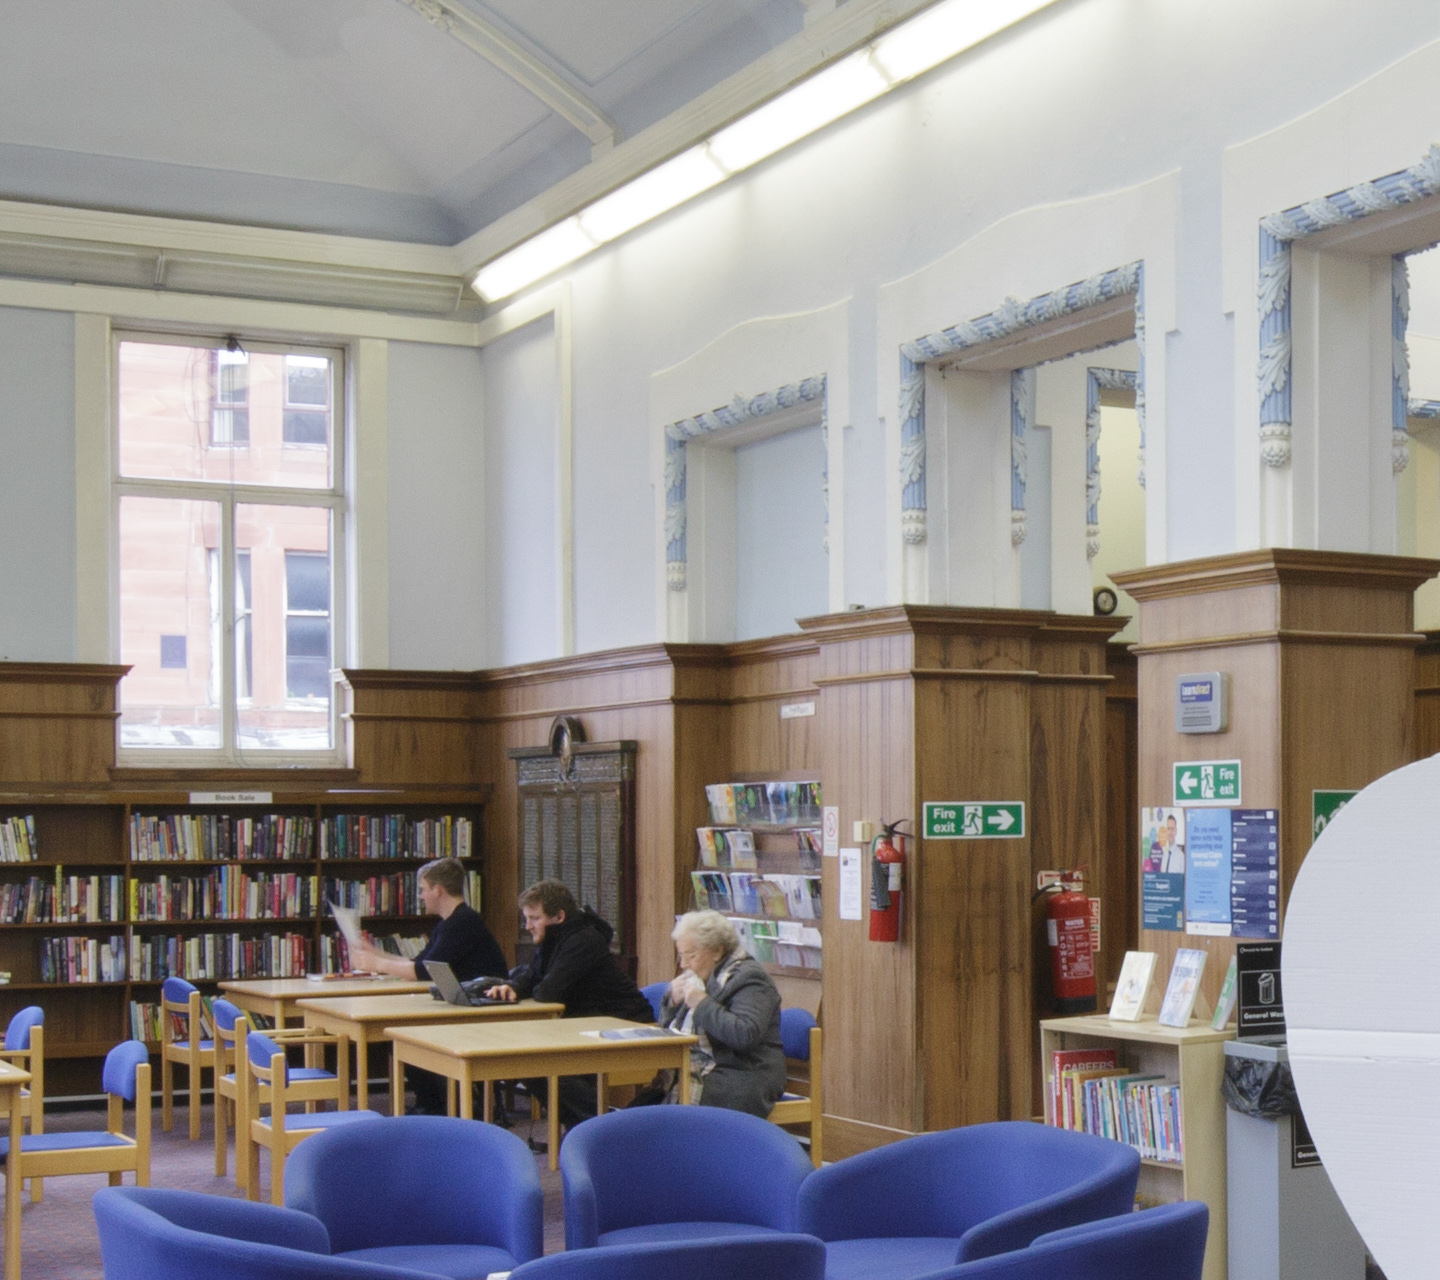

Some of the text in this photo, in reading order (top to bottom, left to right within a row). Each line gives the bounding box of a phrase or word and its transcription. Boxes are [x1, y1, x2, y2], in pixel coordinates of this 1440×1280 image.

[1220, 768, 1235, 780] Fire
[1220, 783, 1235, 795] exit
[933, 808, 955, 819] Fire
[933, 823, 955, 833] exit
[1244, 1011, 1268, 1020] General
